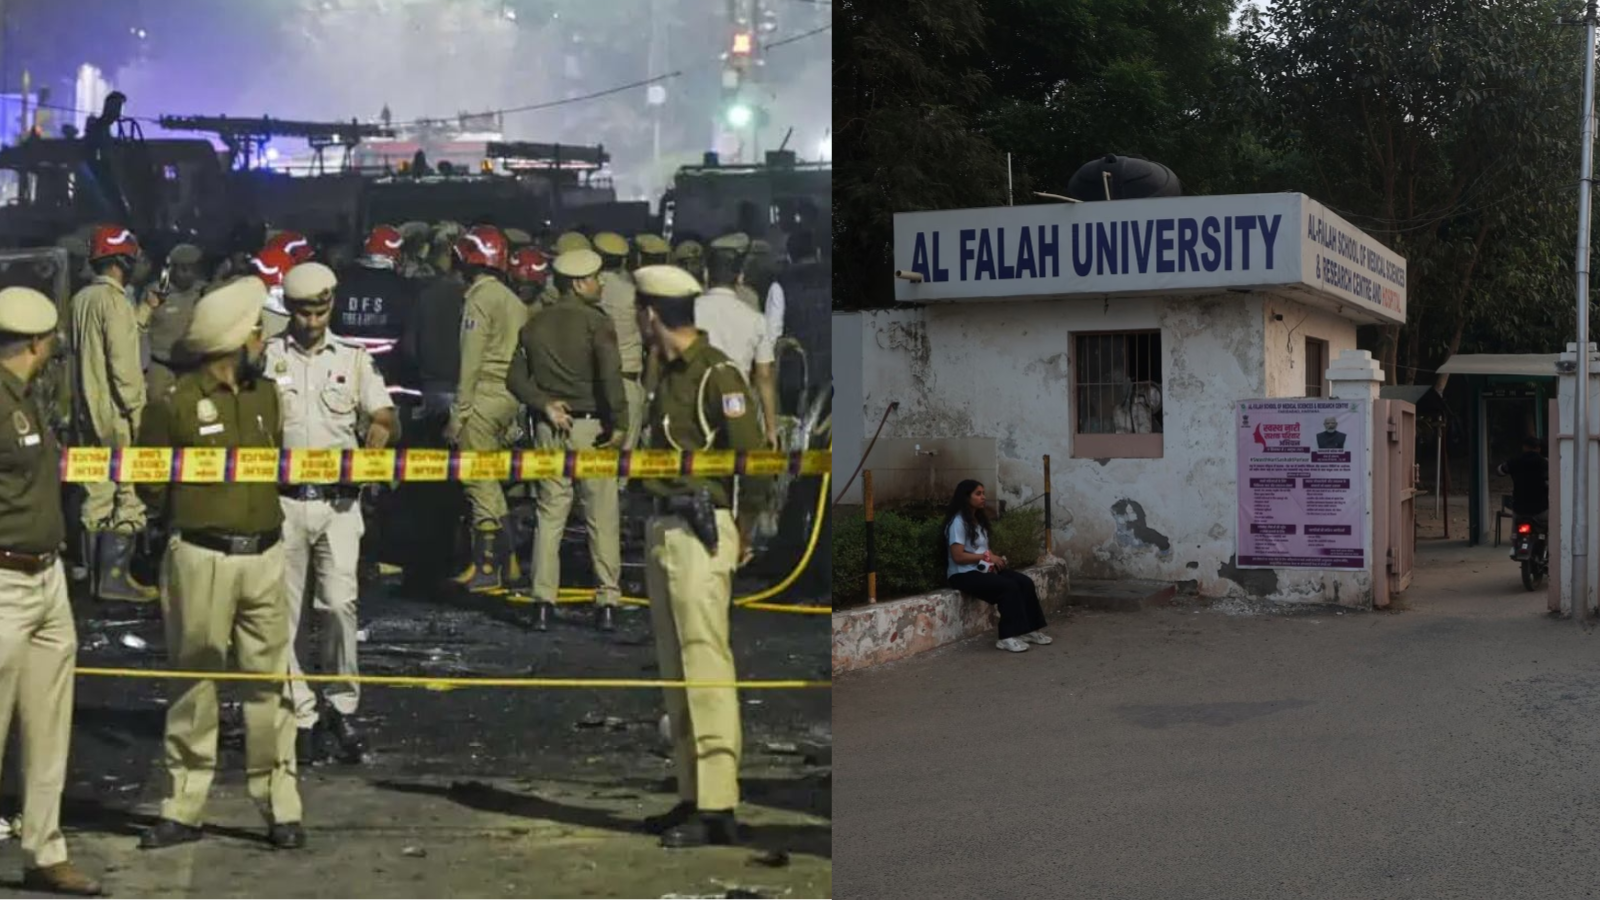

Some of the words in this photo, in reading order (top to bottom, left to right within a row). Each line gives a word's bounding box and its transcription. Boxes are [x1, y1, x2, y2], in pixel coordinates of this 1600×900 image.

[912, 231, 949, 284] AL
[959, 224, 1060, 281] FALAH
[1072, 213, 1283, 277] UNIVERSITY
[1338, 230, 1359, 264] SCHOOL
[1360, 244, 1366, 267] OF
[1367, 247, 1386, 279] MEDICAL
[1316, 253, 1321, 279] &
[1323, 256, 1352, 293] RESEARCH
[1372, 282, 1381, 305] AND
